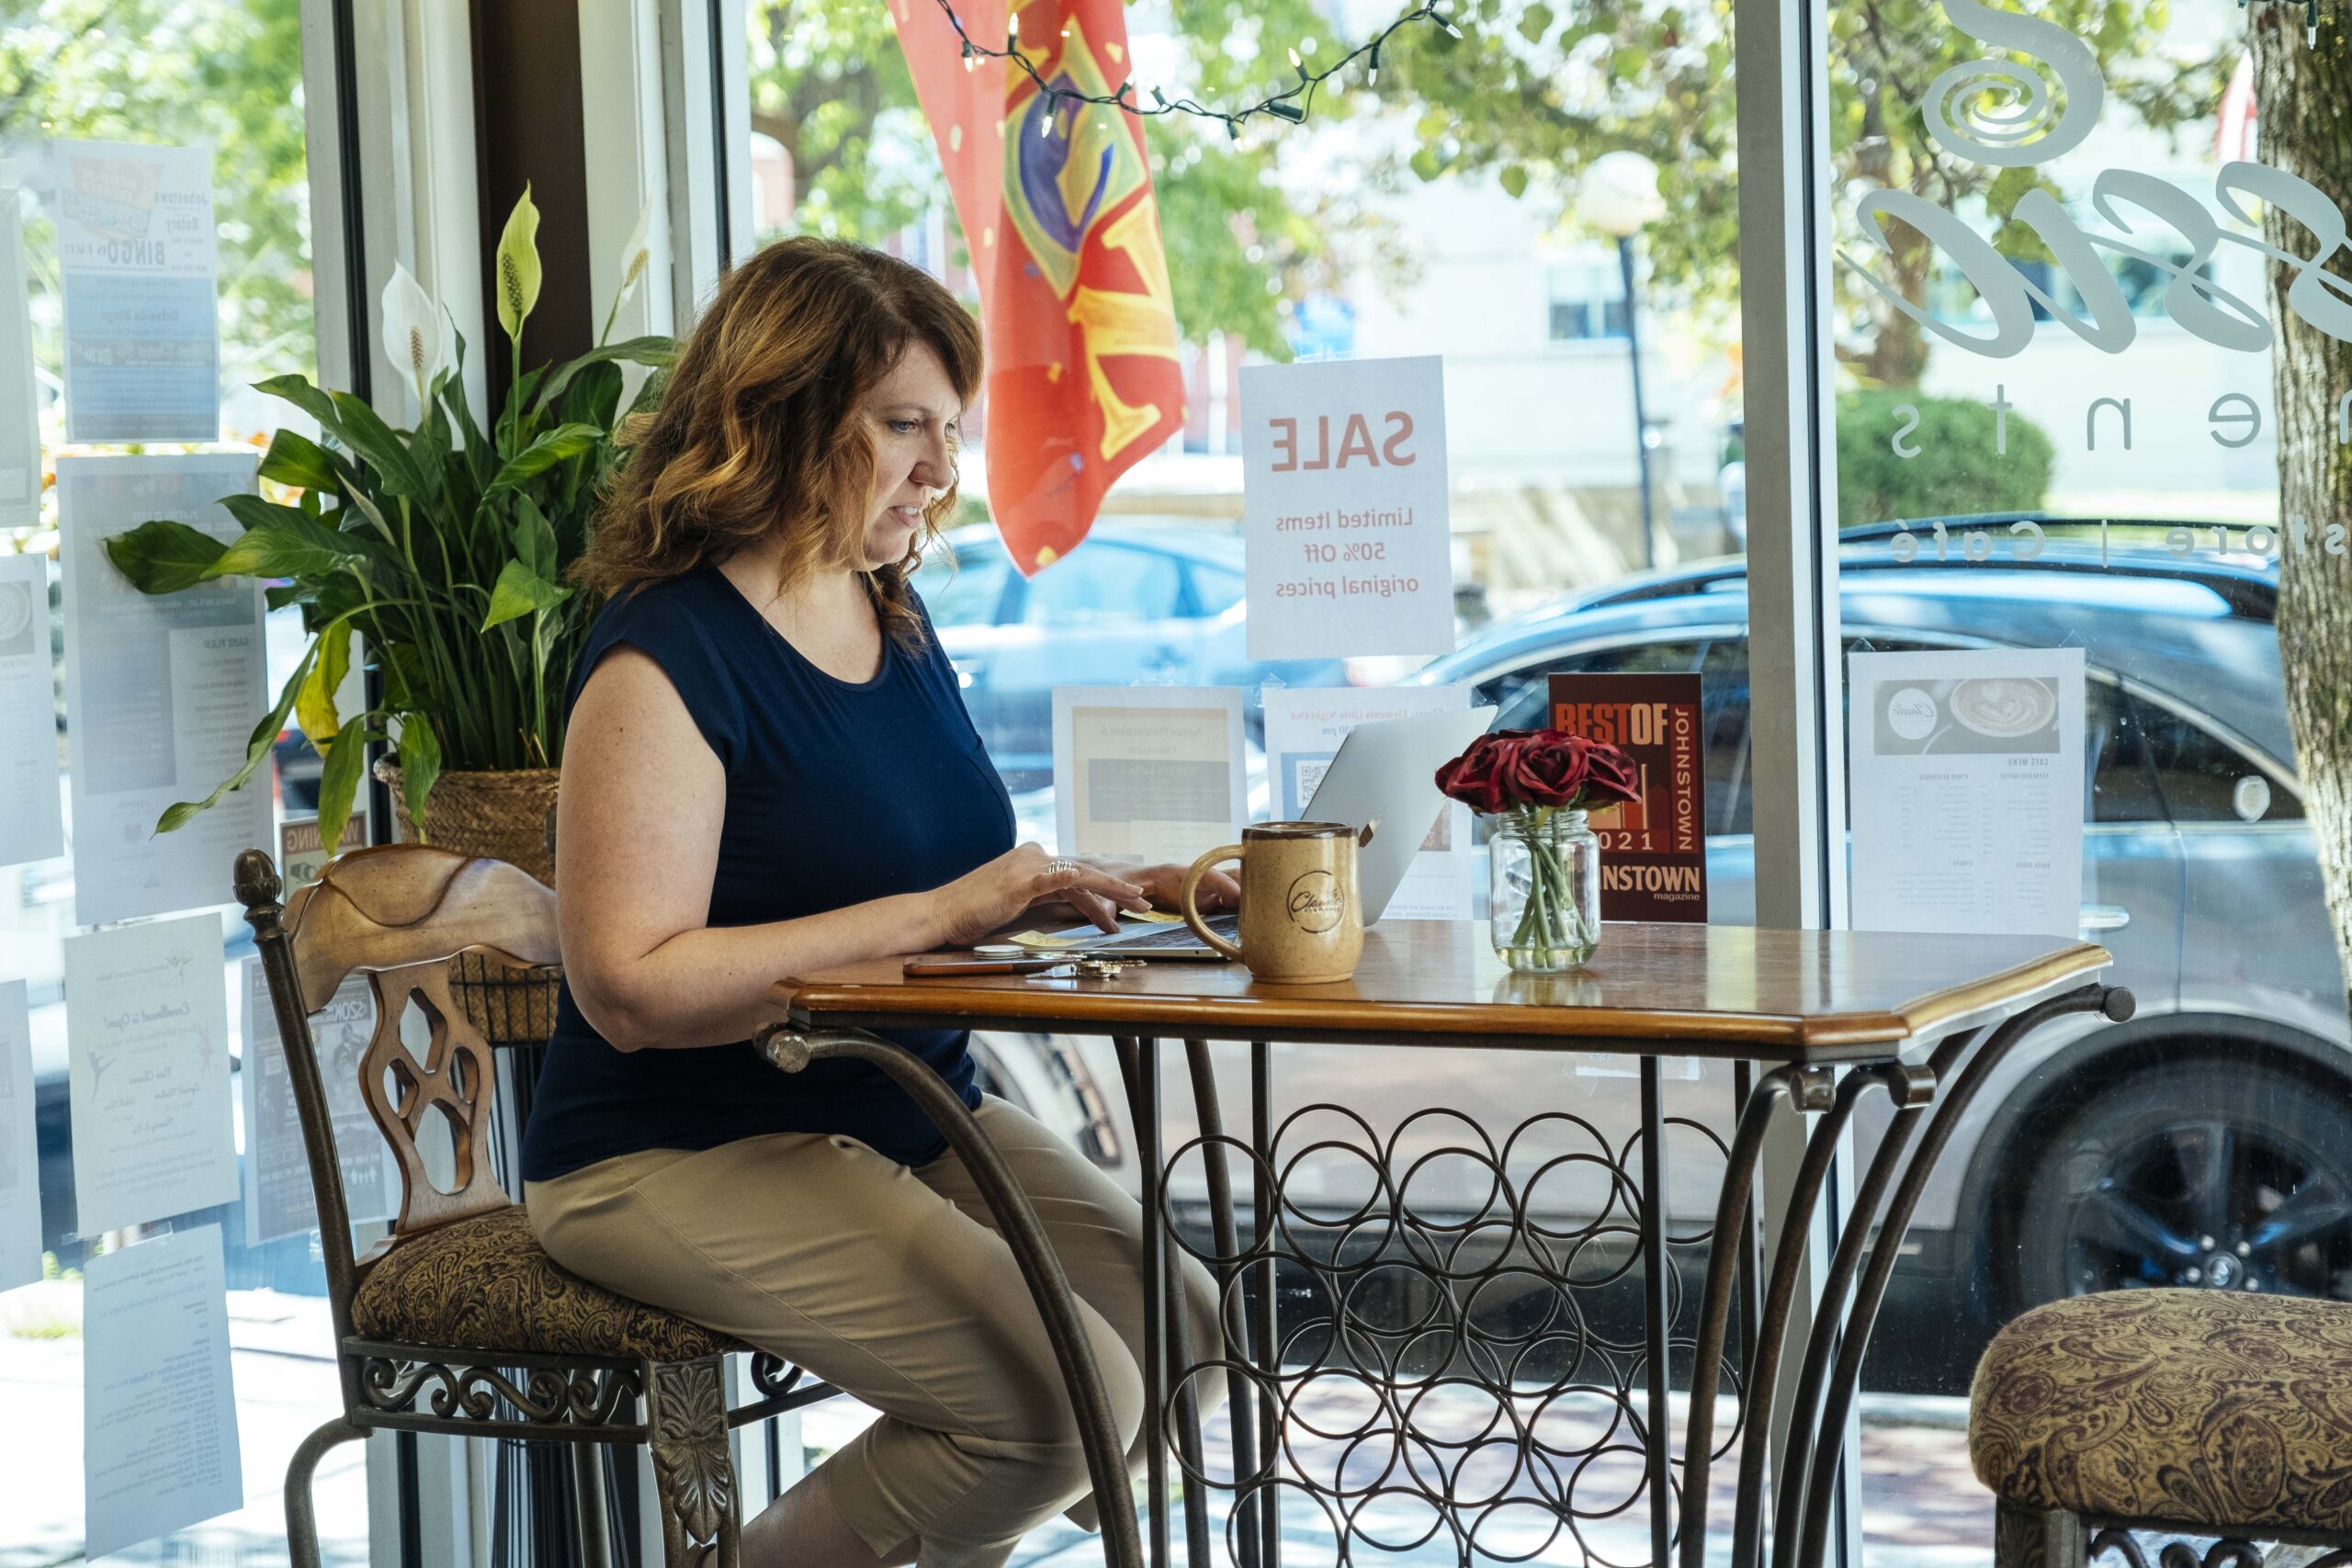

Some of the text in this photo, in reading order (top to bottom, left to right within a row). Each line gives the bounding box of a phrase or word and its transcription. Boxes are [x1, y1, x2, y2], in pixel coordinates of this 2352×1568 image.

[1675, 707, 1693, 851] JOHNSTOWN
[1599, 831, 1654, 851] 021
[1654, 893, 1701, 904] magazine
